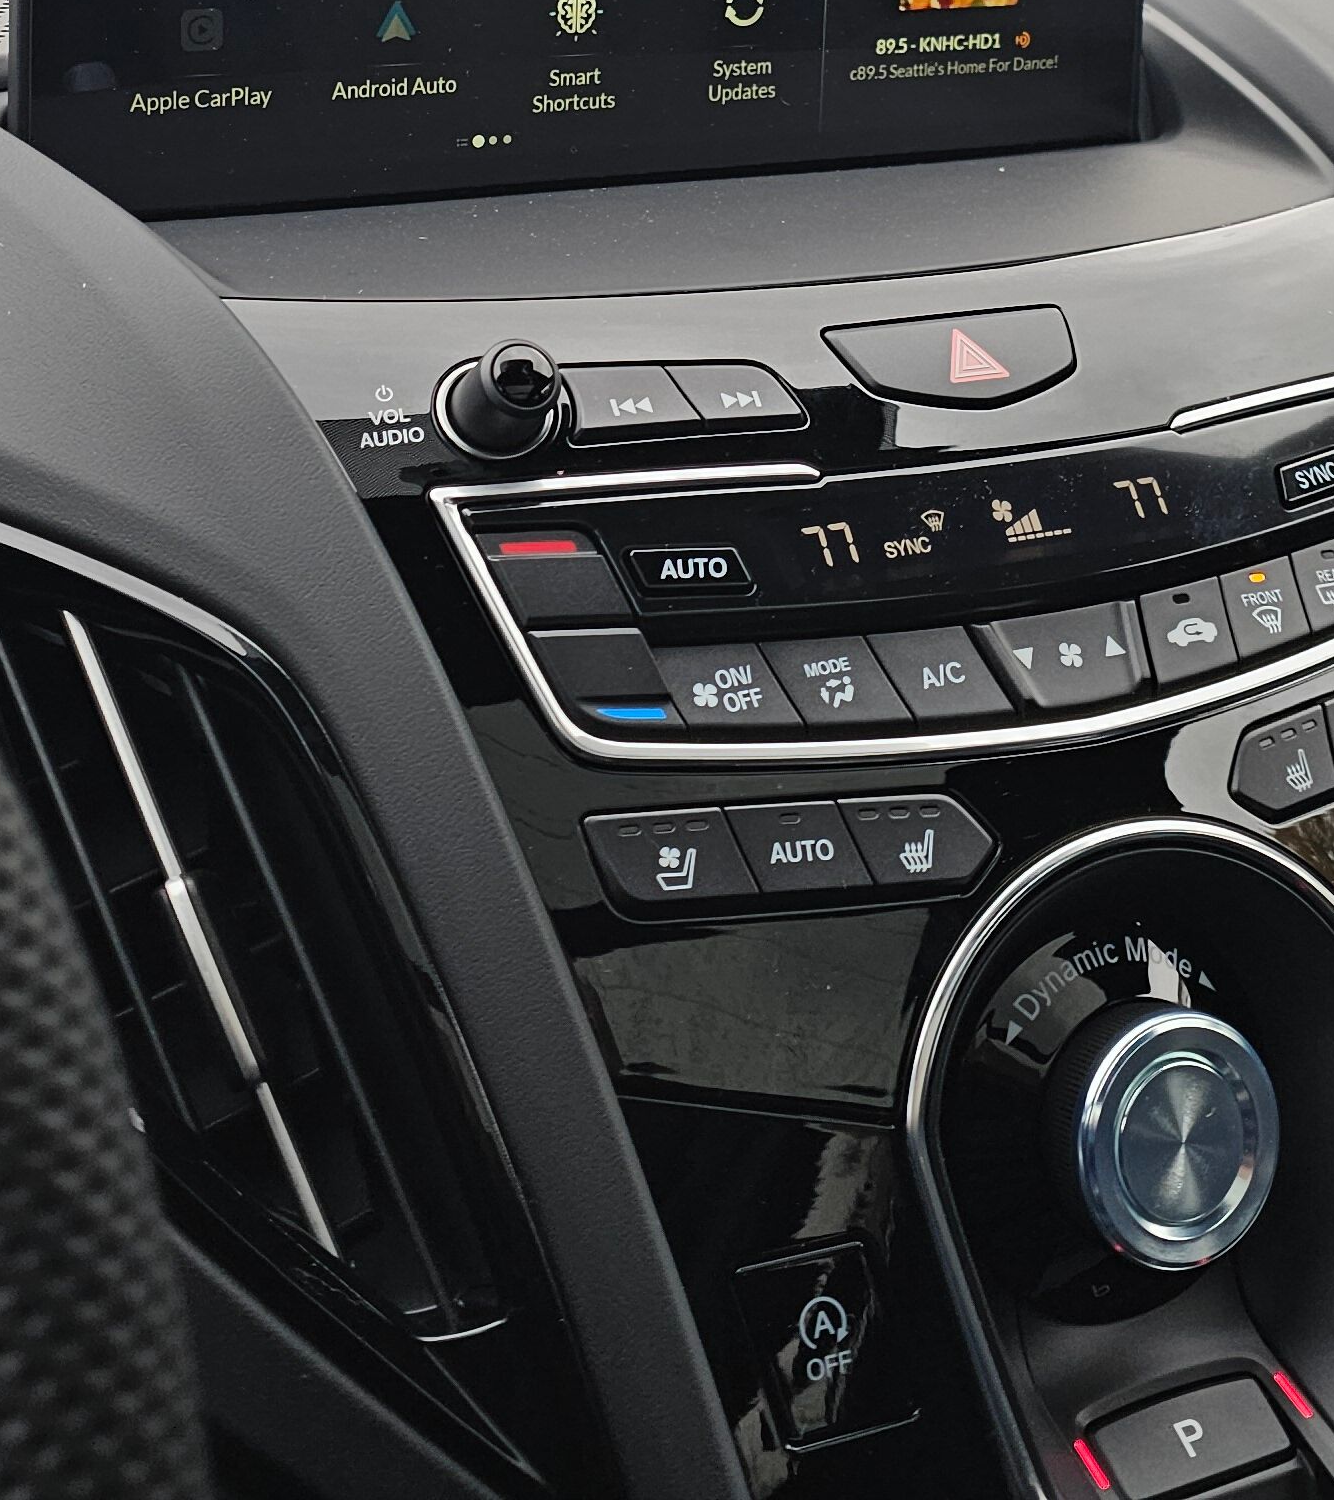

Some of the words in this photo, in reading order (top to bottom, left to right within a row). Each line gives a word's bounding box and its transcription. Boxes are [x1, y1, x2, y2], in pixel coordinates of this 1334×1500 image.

[875, 37, 908, 56] 89.5
[919, 32, 1002, 54] KNHC-HD1
[548, 67, 602, 89] Smart
[712, 58, 773, 80] System
[849, 64, 888, 81] c89.5
[889, 61, 946, 80] Seattle's
[947, 60, 986, 76] Home
[988, 57, 1010, 74] For
[1013, 55, 1059, 72] Dance!
[129, 89, 191, 114] Apple
[193, 86, 273, 113] CarPlay
[331, 77, 407, 101] Android
[410, 74, 458, 97] Auto
[707, 82, 777, 104] Updates
[531, 90, 617, 114] Shortcuts
[367, 408, 411, 425] VOL
[359, 426, 426, 450] AUDIO
[1112, 476, 1169, 519] 77
[800, 521, 861, 568] 77
[883, 536, 933, 559] SYNC
[659, 556, 729, 581] AUTO
[1240, 587, 1285, 608] FRONT
[714, 664, 754, 689] ON/
[803, 656, 852, 679] MODE
[921, 661, 966, 691] A/C
[722, 688, 764, 714] OFF
[769, 837, 836, 865] AUTO
[1012, 941, 1120, 1022] Dynamic
[1124, 936, 1193, 979] Mode
[806, 1349, 854, 1382] OFF
[1172, 1417, 1205, 1458] P
